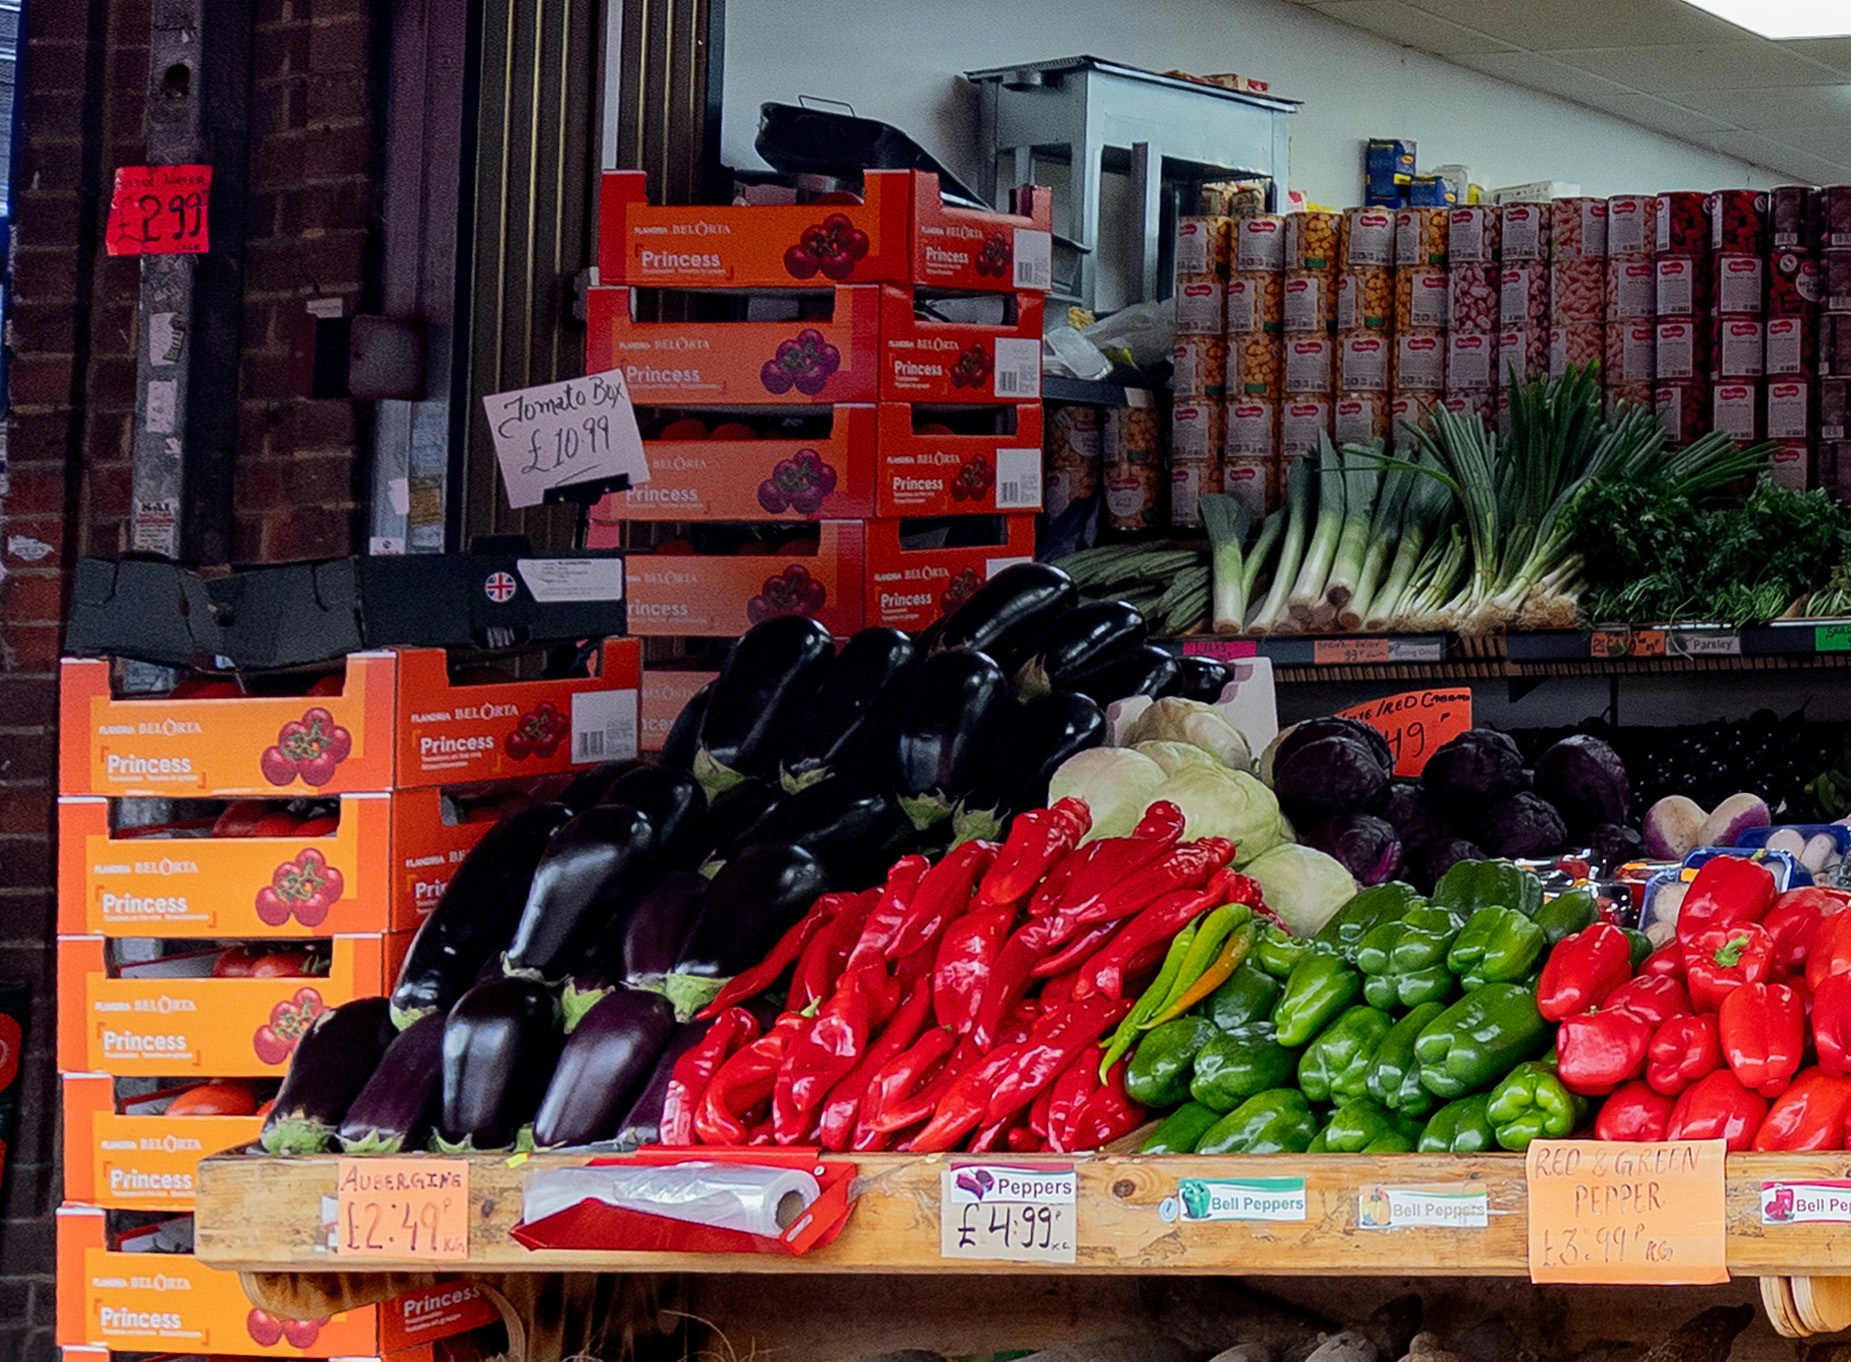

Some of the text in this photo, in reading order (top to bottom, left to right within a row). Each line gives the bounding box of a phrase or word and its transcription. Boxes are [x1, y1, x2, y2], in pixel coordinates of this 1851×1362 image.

[642, 250, 721, 269] Princess
[926, 247, 969, 265] Princess
[626, 366, 701, 383] Princess
[894, 360, 943, 376] Princess
[498, 376, 625, 438] Tomato Box
[626, 486, 698, 503] Princess
[893, 476, 944, 493] Princess
[628, 601, 689, 617] rincess
[880, 592, 932, 608] Princess
[1692, 638, 1733, 654] Parsley
[420, 735, 495, 756] Princess
[106, 754, 192, 774] Princess
[101, 892, 188, 913] Princess
[102, 1030, 187, 1051] Princess
[1535, 1147, 1581, 1179] RED
[1614, 1145, 1702, 1177] GREEN
[109, 1168, 192, 1190] Princess
[340, 1164, 462, 1193] AUBERGINE
[997, 1178, 1072, 1199] Peppers
[1211, 1197, 1304, 1215] Bell Peppers
[1574, 1181, 1665, 1218] PEPPER
[1796, 1198, 1825, 1212] Bell
[1393, 1202, 1485, 1222] Bell Peppers
[403, 1283, 481, 1317] Princess
[100, 1307, 182, 1330] Princess
